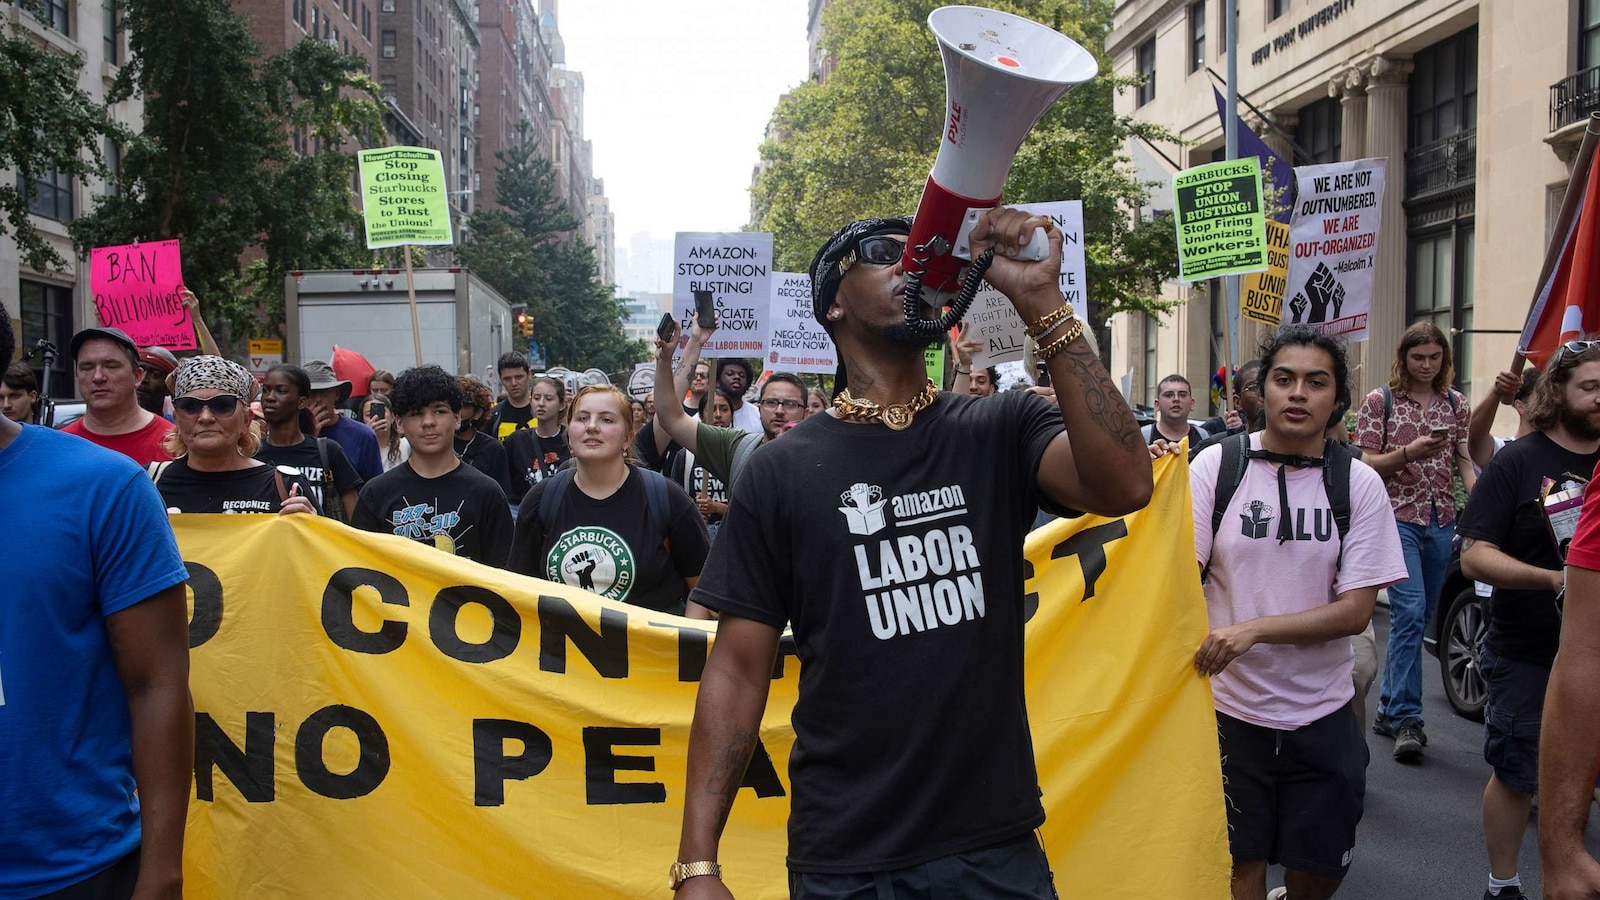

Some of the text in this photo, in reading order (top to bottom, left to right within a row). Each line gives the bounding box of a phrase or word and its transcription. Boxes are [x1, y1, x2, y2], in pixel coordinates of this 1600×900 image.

[1251, 43, 1271, 67] NEW
[1273, 27, 1297, 54] YORK
[948, 98, 961, 145] PYLE
[385, 160, 418, 171] Stop
[375, 171, 430, 183] Closing
[1176, 164, 1253, 186] STARBUCKS:
[1313, 170, 1372, 194] WE ARE NOT
[370, 183, 437, 195] Starbucks
[1195, 181, 1233, 197] STOP
[379, 196, 425, 206] Stores
[1194, 191, 1240, 208] UNION
[1301, 191, 1377, 217] OUTNUMBERED,
[381, 206, 430, 217] to Bust
[1186, 201, 1252, 222] BUSTING!
[389, 218, 433, 228] Unions!
[1183, 217, 1253, 235] Stop Firing
[1323, 215, 1360, 235] WE ARE
[1185, 228, 1253, 245] Unionizing
[688, 246, 757, 260] AMAZON:
[1183, 237, 1260, 258] Workers!
[1295, 232, 1376, 259] OUT-ORGANIZED!
[106, 250, 157, 285] BAN
[1367, 254, 1374, 268] X
[678, 263, 766, 277] STOP UNION
[690, 281, 753, 294] BUSTING!
[783, 278, 811, 288] AMAZ
[777, 288, 812, 299] RECOG
[92, 284, 187, 328] BILLIONAIRES
[716, 296, 725, 308] &
[795, 299, 812, 309] THE
[985, 296, 1006, 310] ARE
[972, 308, 1016, 324] FIGHTIN
[722, 320, 758, 331] NOW!
[798, 322, 805, 331] &
[980, 324, 1004, 336] FOR
[774, 331, 828, 342] NEGOCIATE
[989, 335, 1024, 352] ALL
[715, 340, 739, 350] LABOR
[739, 340, 763, 350] UNION
[771, 339, 830, 351] FAIRLY NOW!
[222, 499, 271, 511] RECOGNIZE
[891, 483, 967, 520] amazon
[393, 503, 435, 525] ミスター
[559, 531, 624, 557] STARBUCKS
[853, 525, 981, 592] LABOR
[606, 570, 630, 600] NITED
[865, 571, 986, 641] UNION
[195, 703, 391, 803] NO
